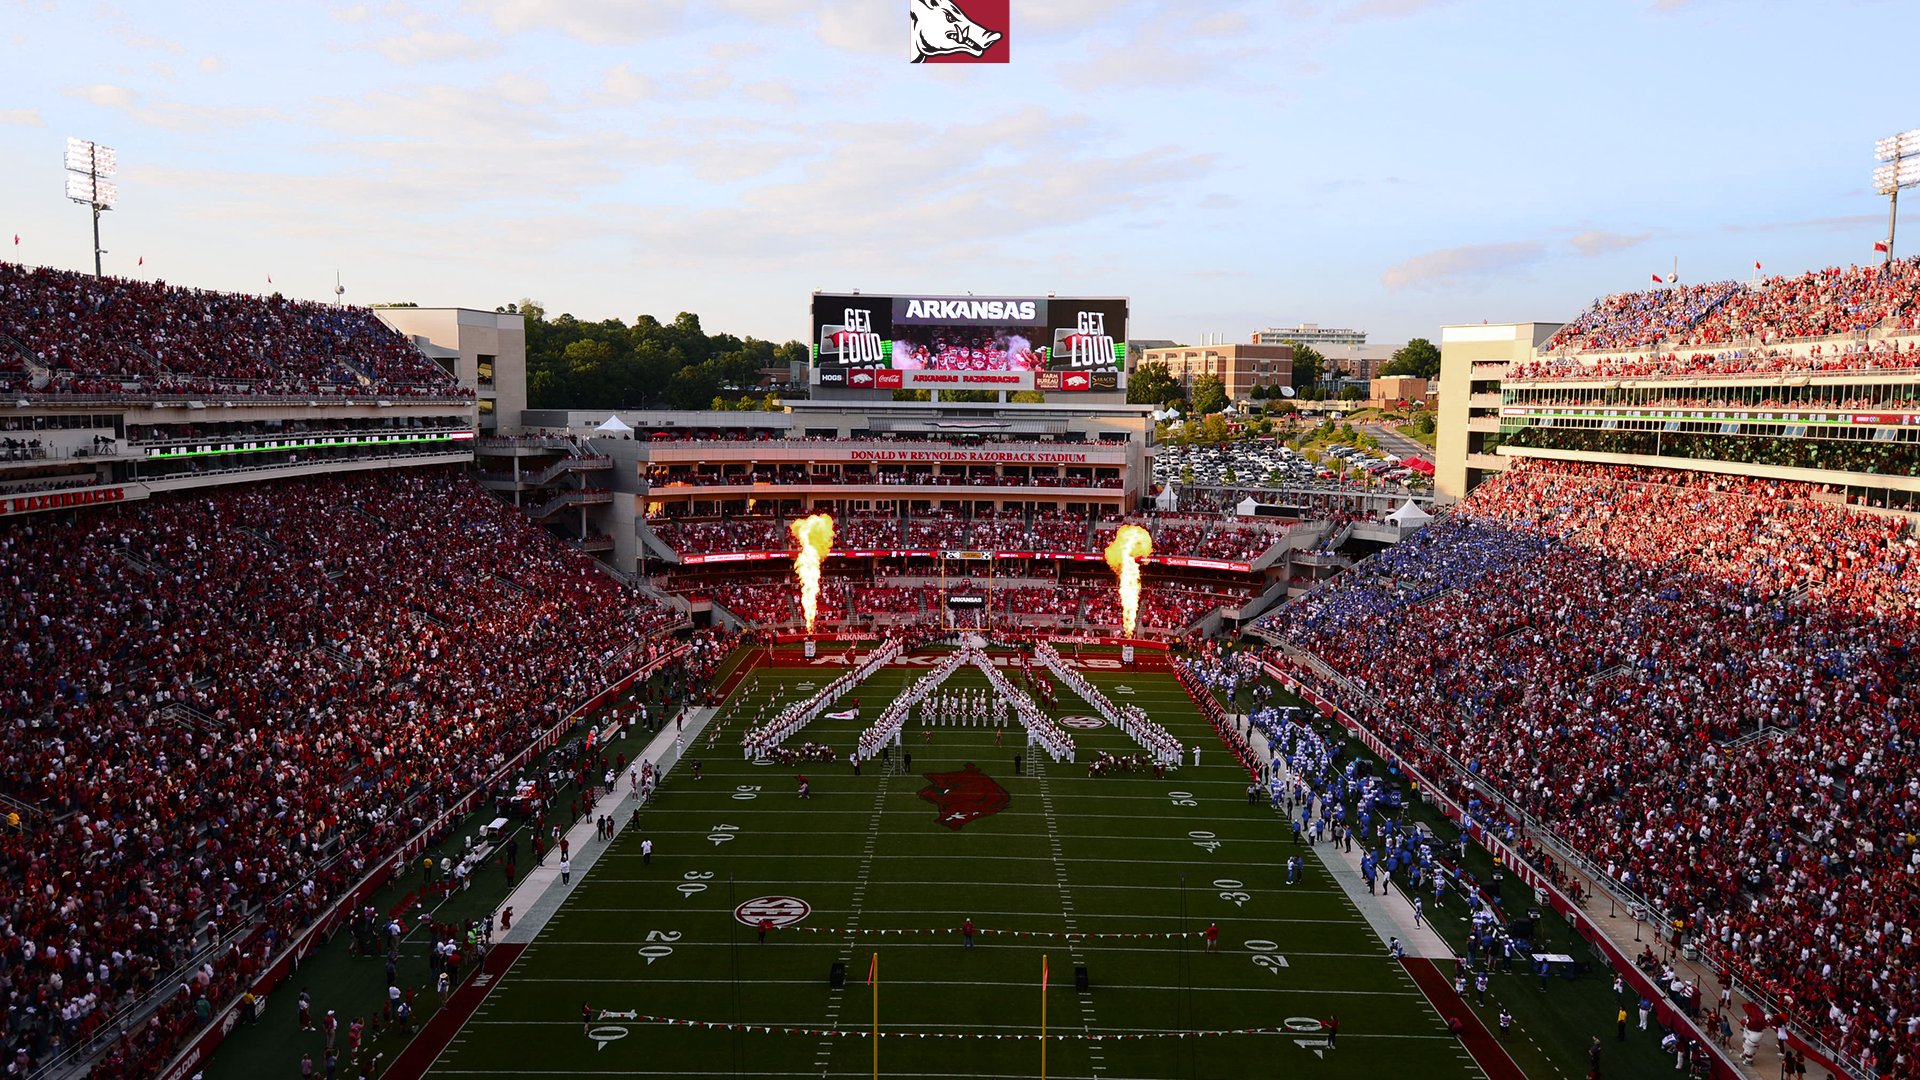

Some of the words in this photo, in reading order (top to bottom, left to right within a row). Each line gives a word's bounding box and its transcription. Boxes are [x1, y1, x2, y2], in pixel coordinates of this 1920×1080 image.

[844, 308, 871, 333] GET
[905, 300, 1036, 320] ARKANSAS
[1077, 311, 1104, 336] GET
[839, 333, 884, 364] LOUD
[1071, 336, 1116, 367] LOUD
[851, 450, 895, 460] DONALD
[899, 451, 907, 460] W
[911, 451, 966, 460] REYNOLDS
[969, 452, 1035, 461] RAZORBACK
[1038, 453, 1086, 462] STADIUM
[13, 488, 124, 512] RAZORBACKS
[836, 633, 878, 641] ARKANSAS
[1049, 636, 1100, 644] RAZORACKS
[706, 824, 740, 842] 40
[1188, 831, 1221, 849] 40
[676, 870, 714, 893] 30
[1213, 879, 1251, 901] 30
[638, 930, 682, 957] 20
[1244, 940, 1290, 968] 20
[588, 1009, 638, 1041] 10
[1284, 1016, 1332, 1049] 10
